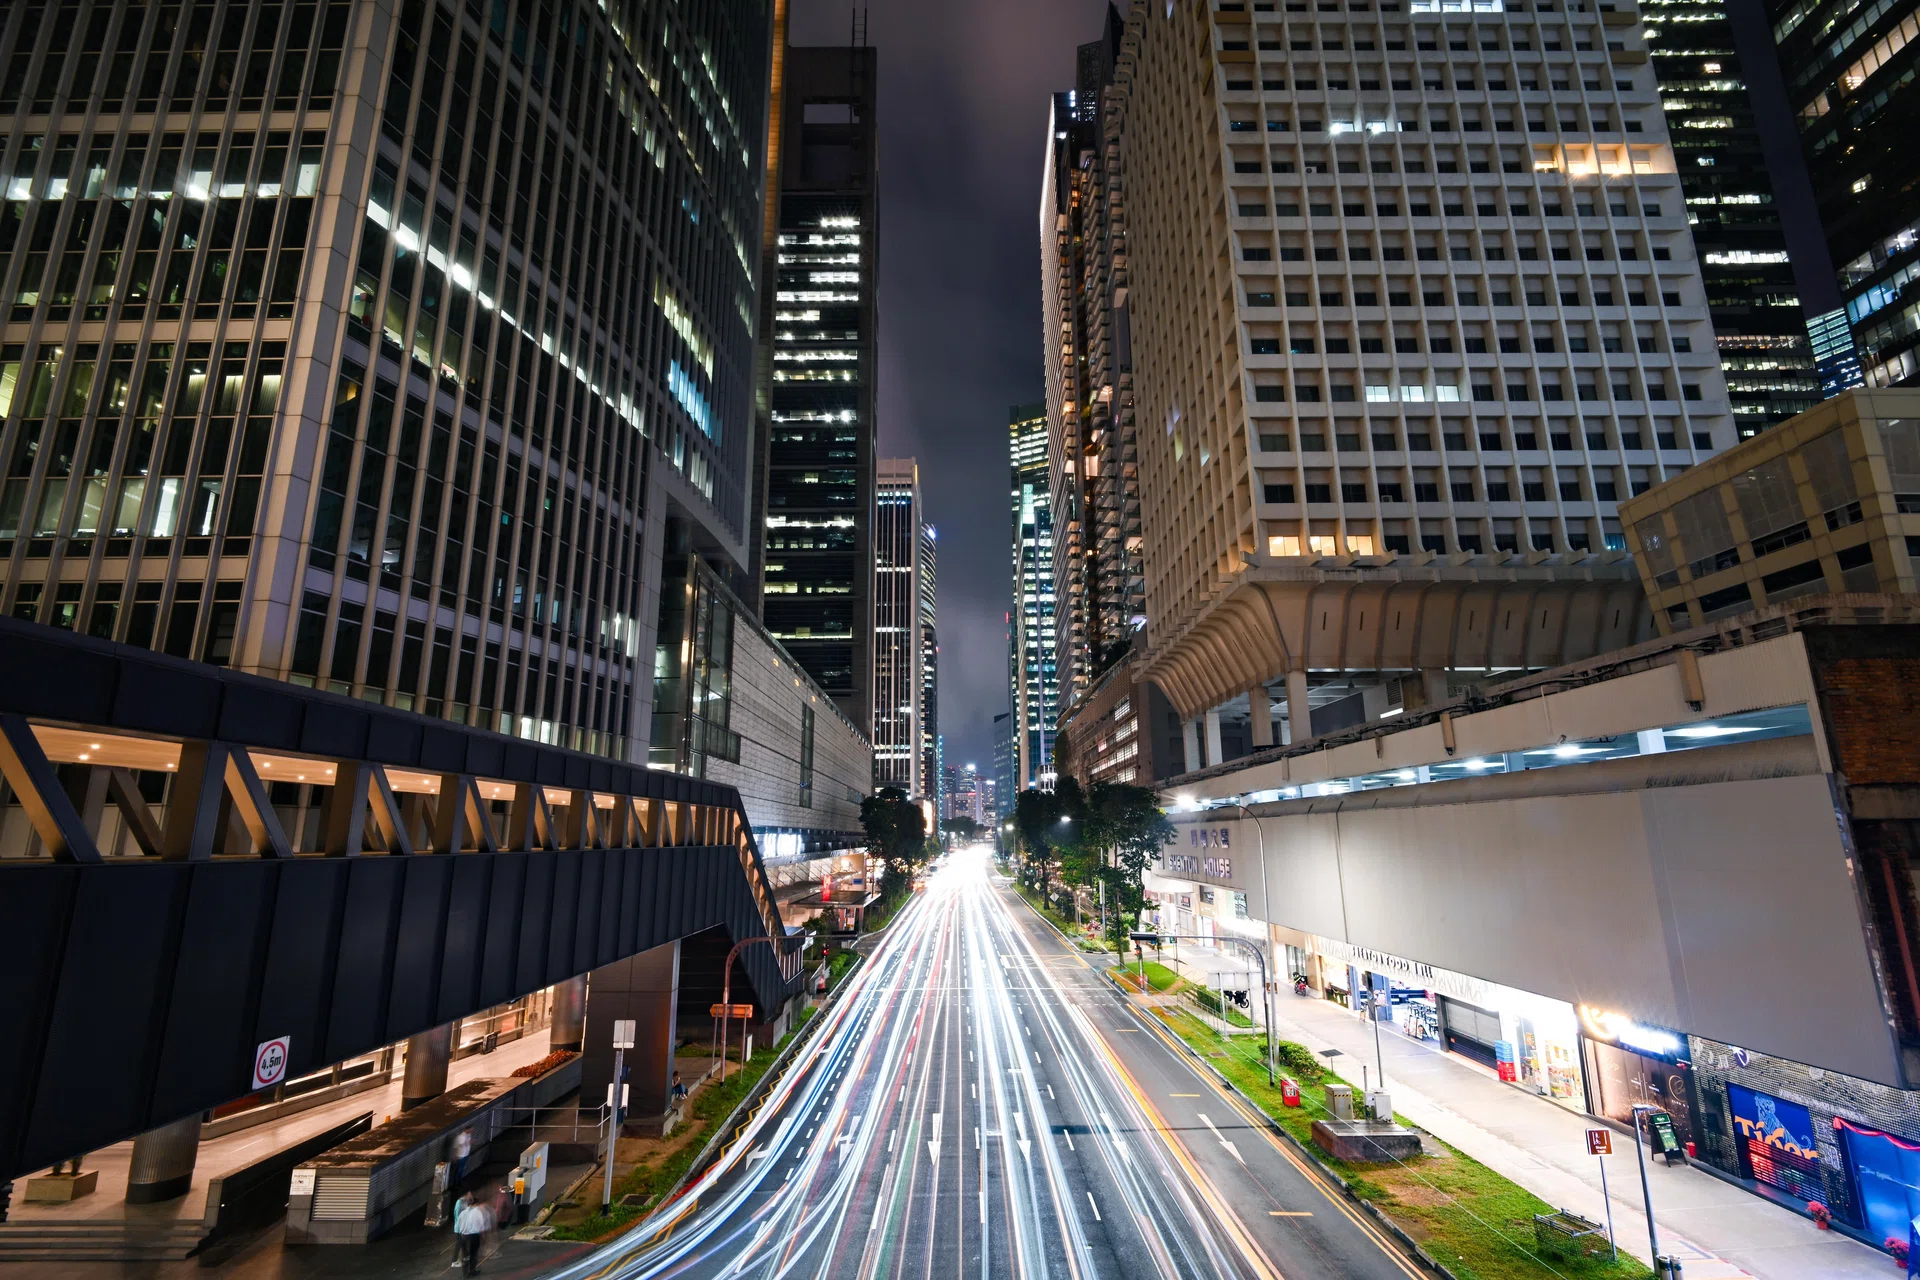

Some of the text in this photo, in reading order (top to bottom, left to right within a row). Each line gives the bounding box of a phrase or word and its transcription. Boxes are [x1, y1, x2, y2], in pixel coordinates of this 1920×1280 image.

[1169, 854, 1232, 879] SHENTON HOUSE
[1385, 956, 1410, 971] FOOD
[261, 1056, 282, 1070] 4.5m
